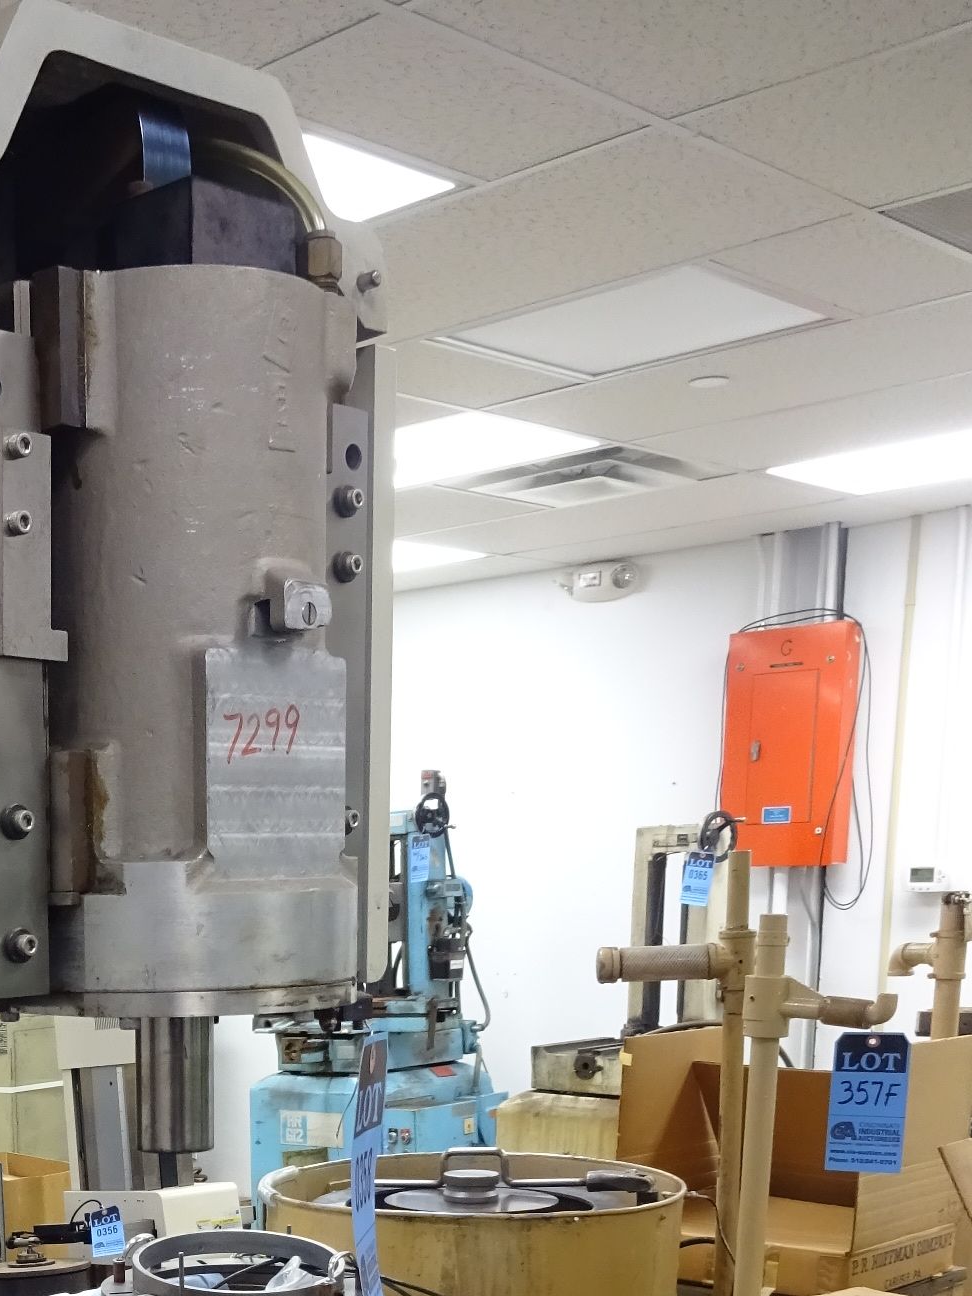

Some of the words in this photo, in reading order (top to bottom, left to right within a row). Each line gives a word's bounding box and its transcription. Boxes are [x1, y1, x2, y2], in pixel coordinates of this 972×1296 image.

[223, 703, 300, 764] 7299
[689, 858, 712, 868] LOT
[841, 1052, 901, 1071] LOT
[837, 1080, 901, 1107] 357F
[355, 1081, 383, 1131] LOT
[858, 1128, 900, 1137] INDUSTRIAL
[94, 1213, 118, 1227] LOT
[96, 1225, 118, 1237] 0356
